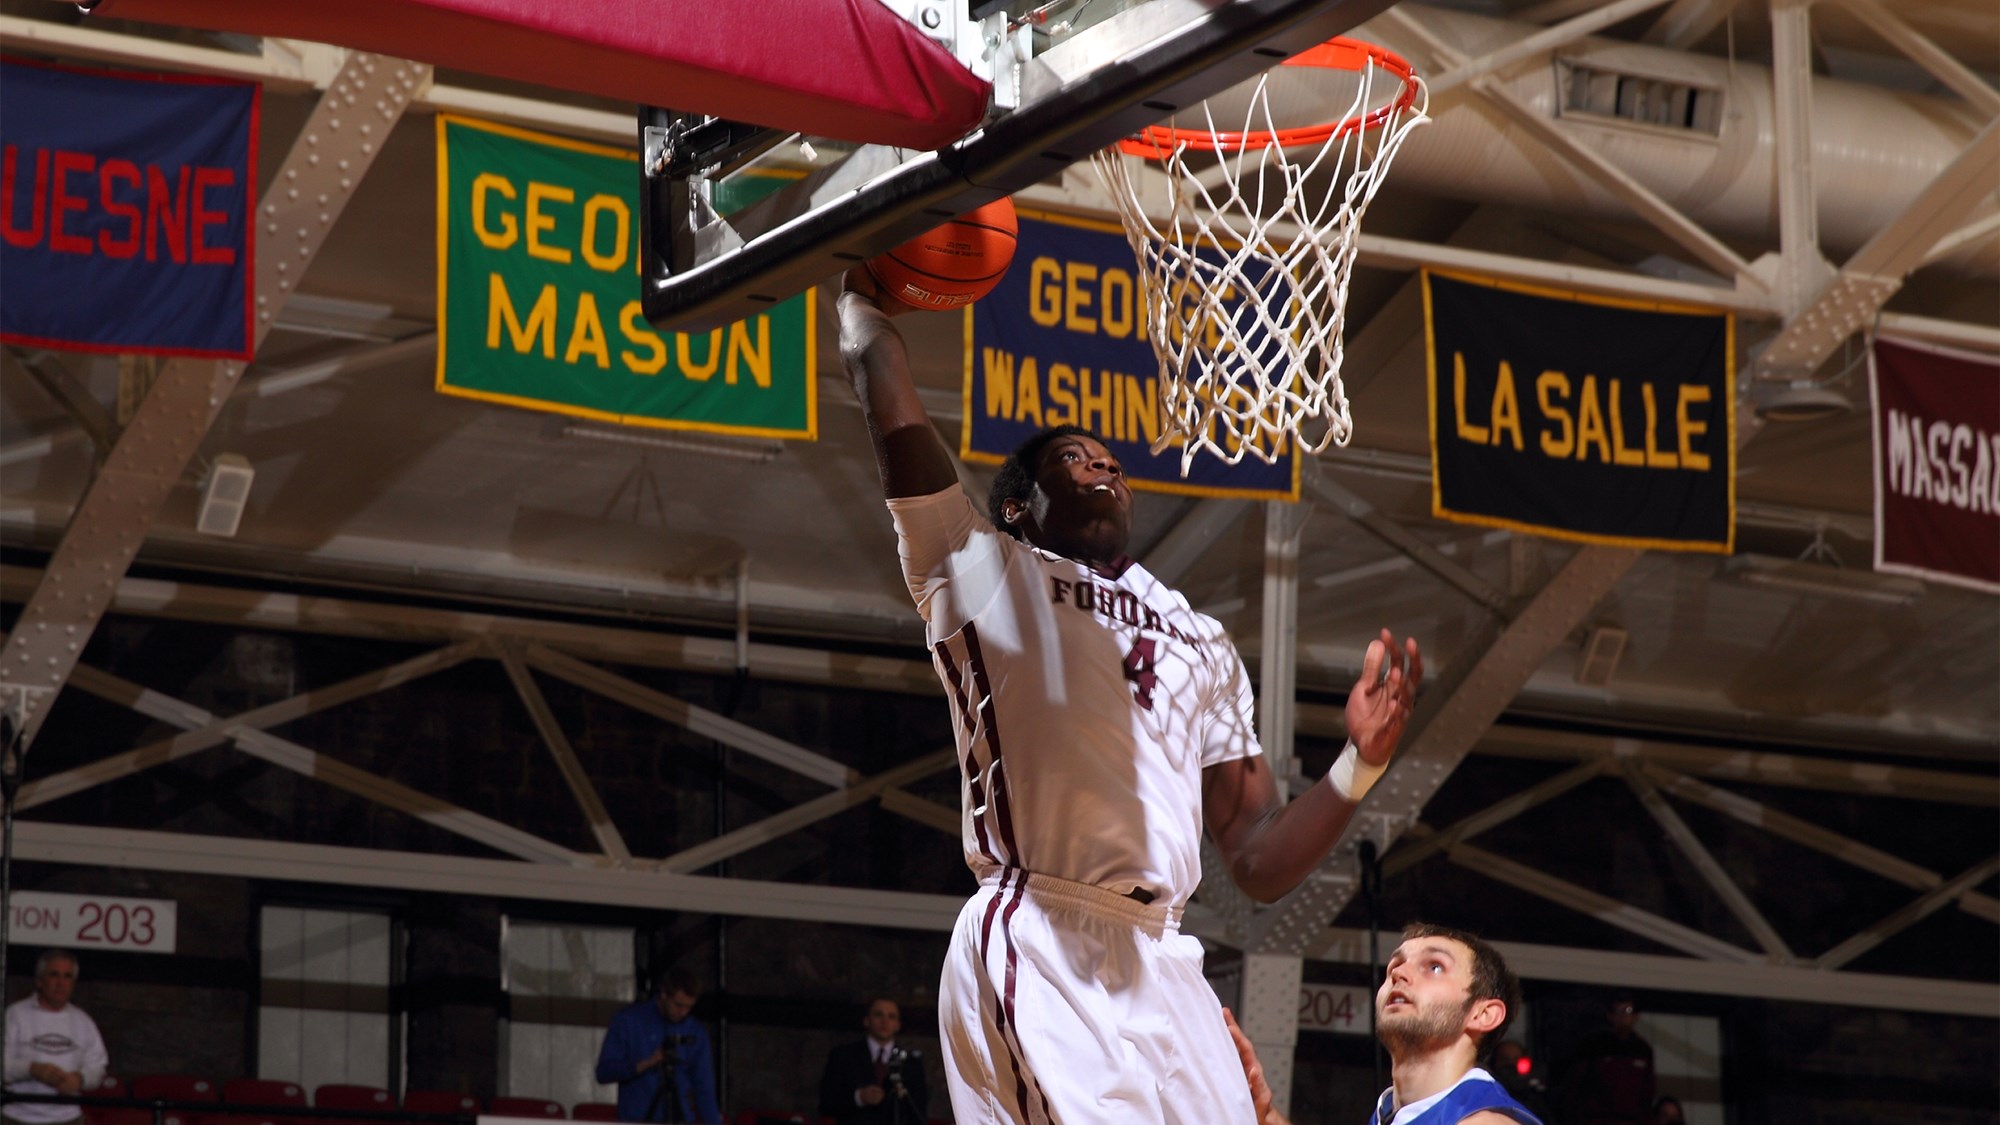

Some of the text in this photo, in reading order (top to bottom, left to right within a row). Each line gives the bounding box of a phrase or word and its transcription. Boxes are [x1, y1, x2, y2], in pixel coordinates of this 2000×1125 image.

[471, 172, 641, 276] GEO
[486, 272, 771, 388] MASON
[1454, 351, 1711, 471] LA SALLE
[1122, 635, 1158, 712] 4
[76, 902, 156, 945] 203
[1299, 987, 1354, 1026] 204
